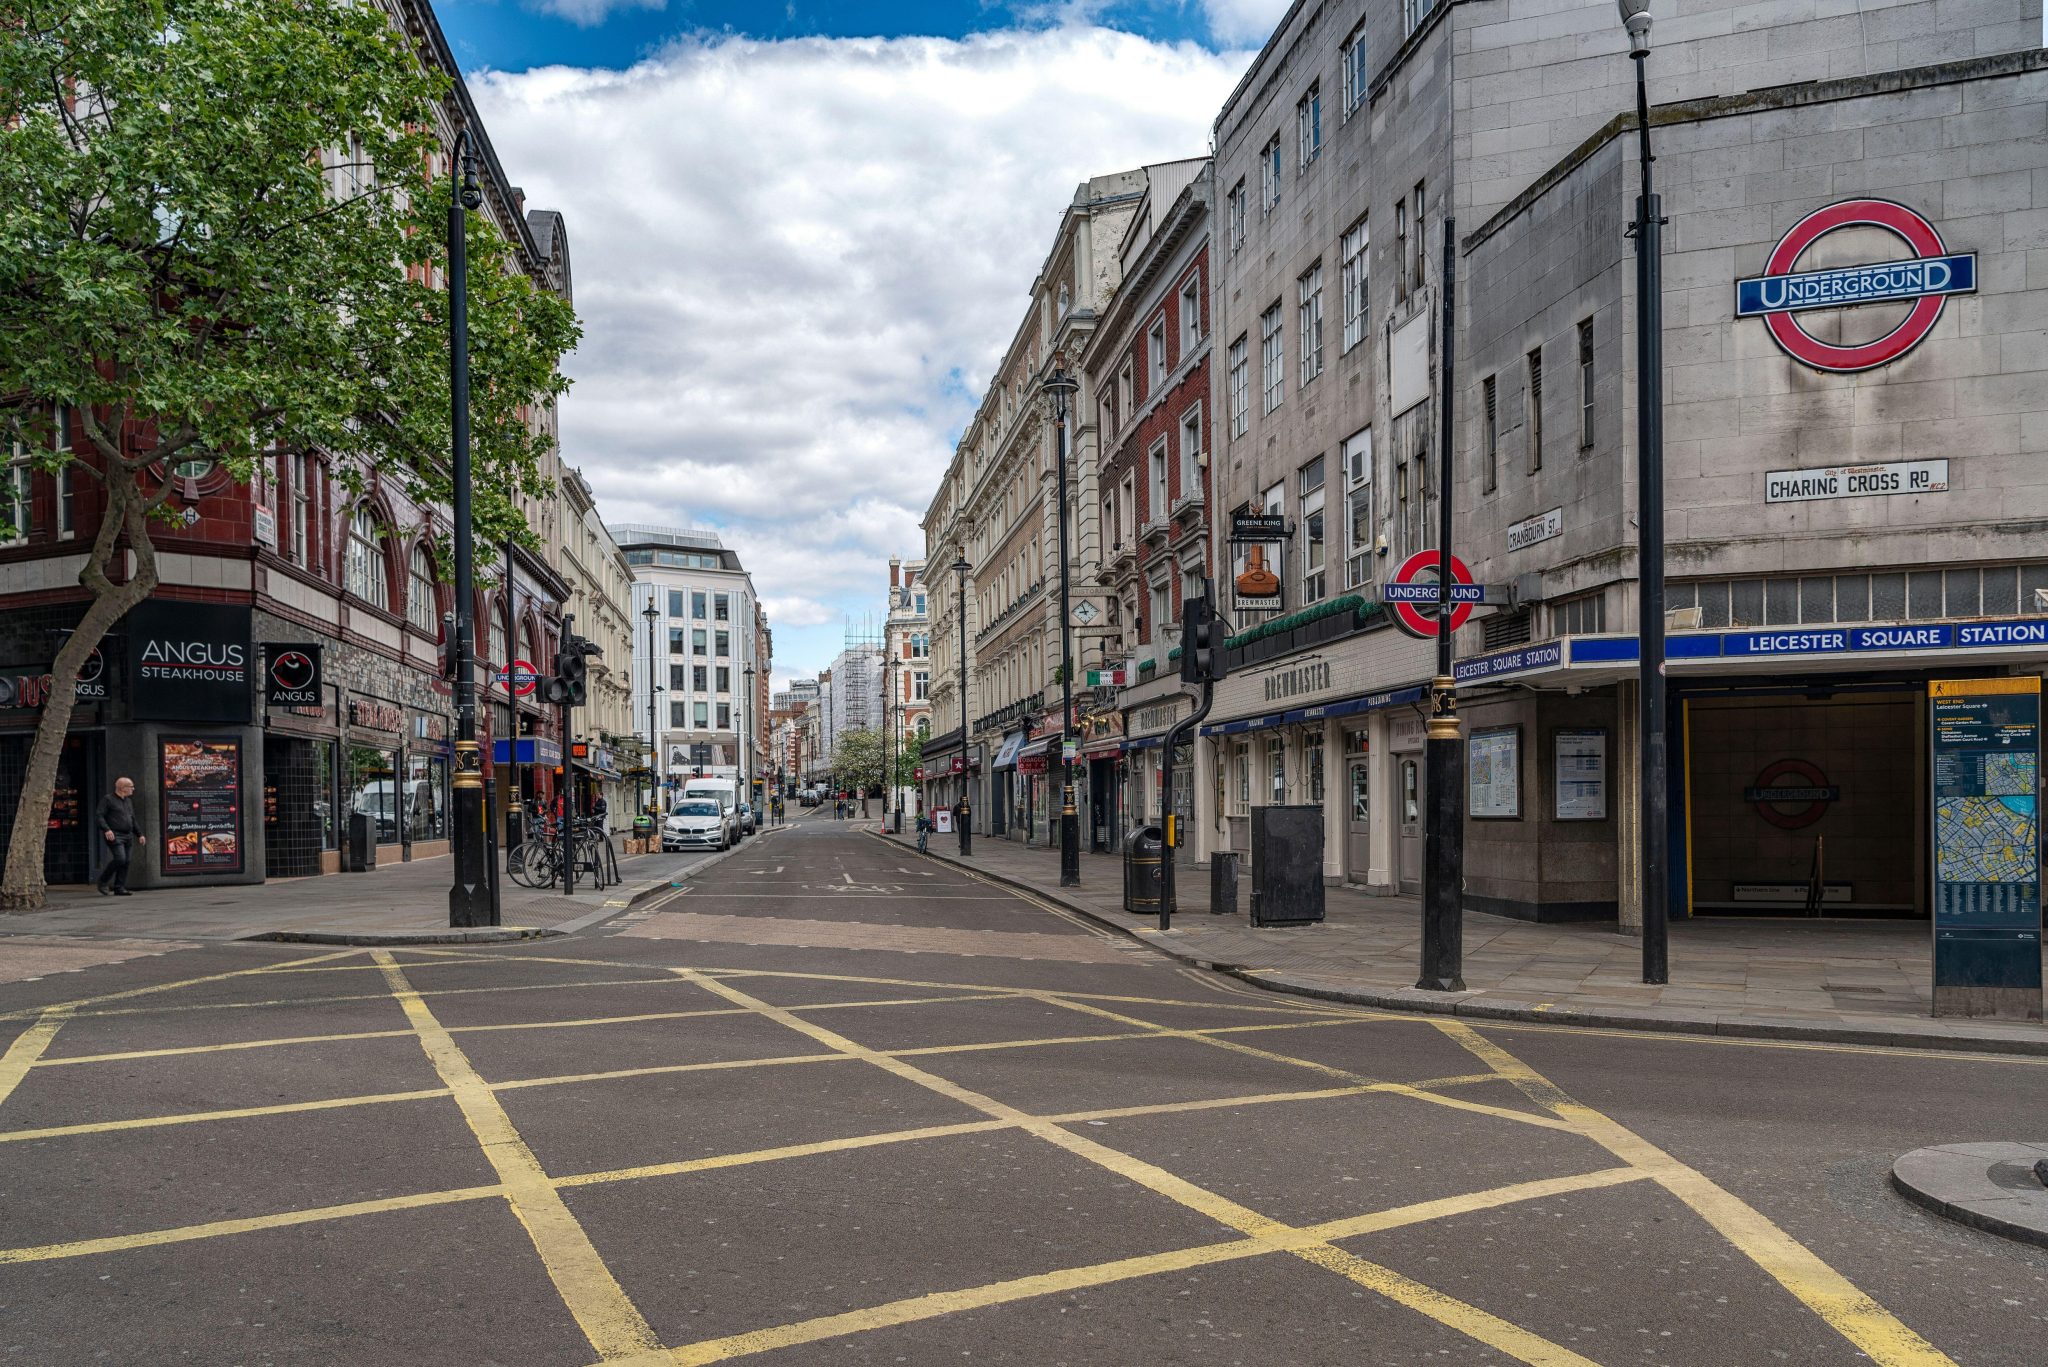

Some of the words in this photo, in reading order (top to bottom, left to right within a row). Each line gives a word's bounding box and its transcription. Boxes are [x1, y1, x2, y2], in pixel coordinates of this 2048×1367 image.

[1760, 261, 1952, 307] UNDERGROUND
[1770, 477, 1838, 498] CHARING
[1848, 472, 1899, 492] CROSS
[1508, 521, 1545, 548] CRANBOURN
[1388, 587, 1480, 599] UNDERGUND
[1750, 633, 1844, 651] LEICESTER
[1861, 629, 1941, 647] SQUARE
[1960, 624, 2045, 643] STATION
[141, 639, 244, 666] ANGUS
[1456, 661, 1489, 679] LEICESTER
[1492, 654, 1522, 671] SQUARE
[1526, 647, 1559, 666] STATION
[141, 666, 244, 682] STEAKHOUSE
[1264, 661, 1331, 702] BREWMASTER
[74, 683, 105, 696] NGUS
[272, 691, 316, 702] ANGUS
